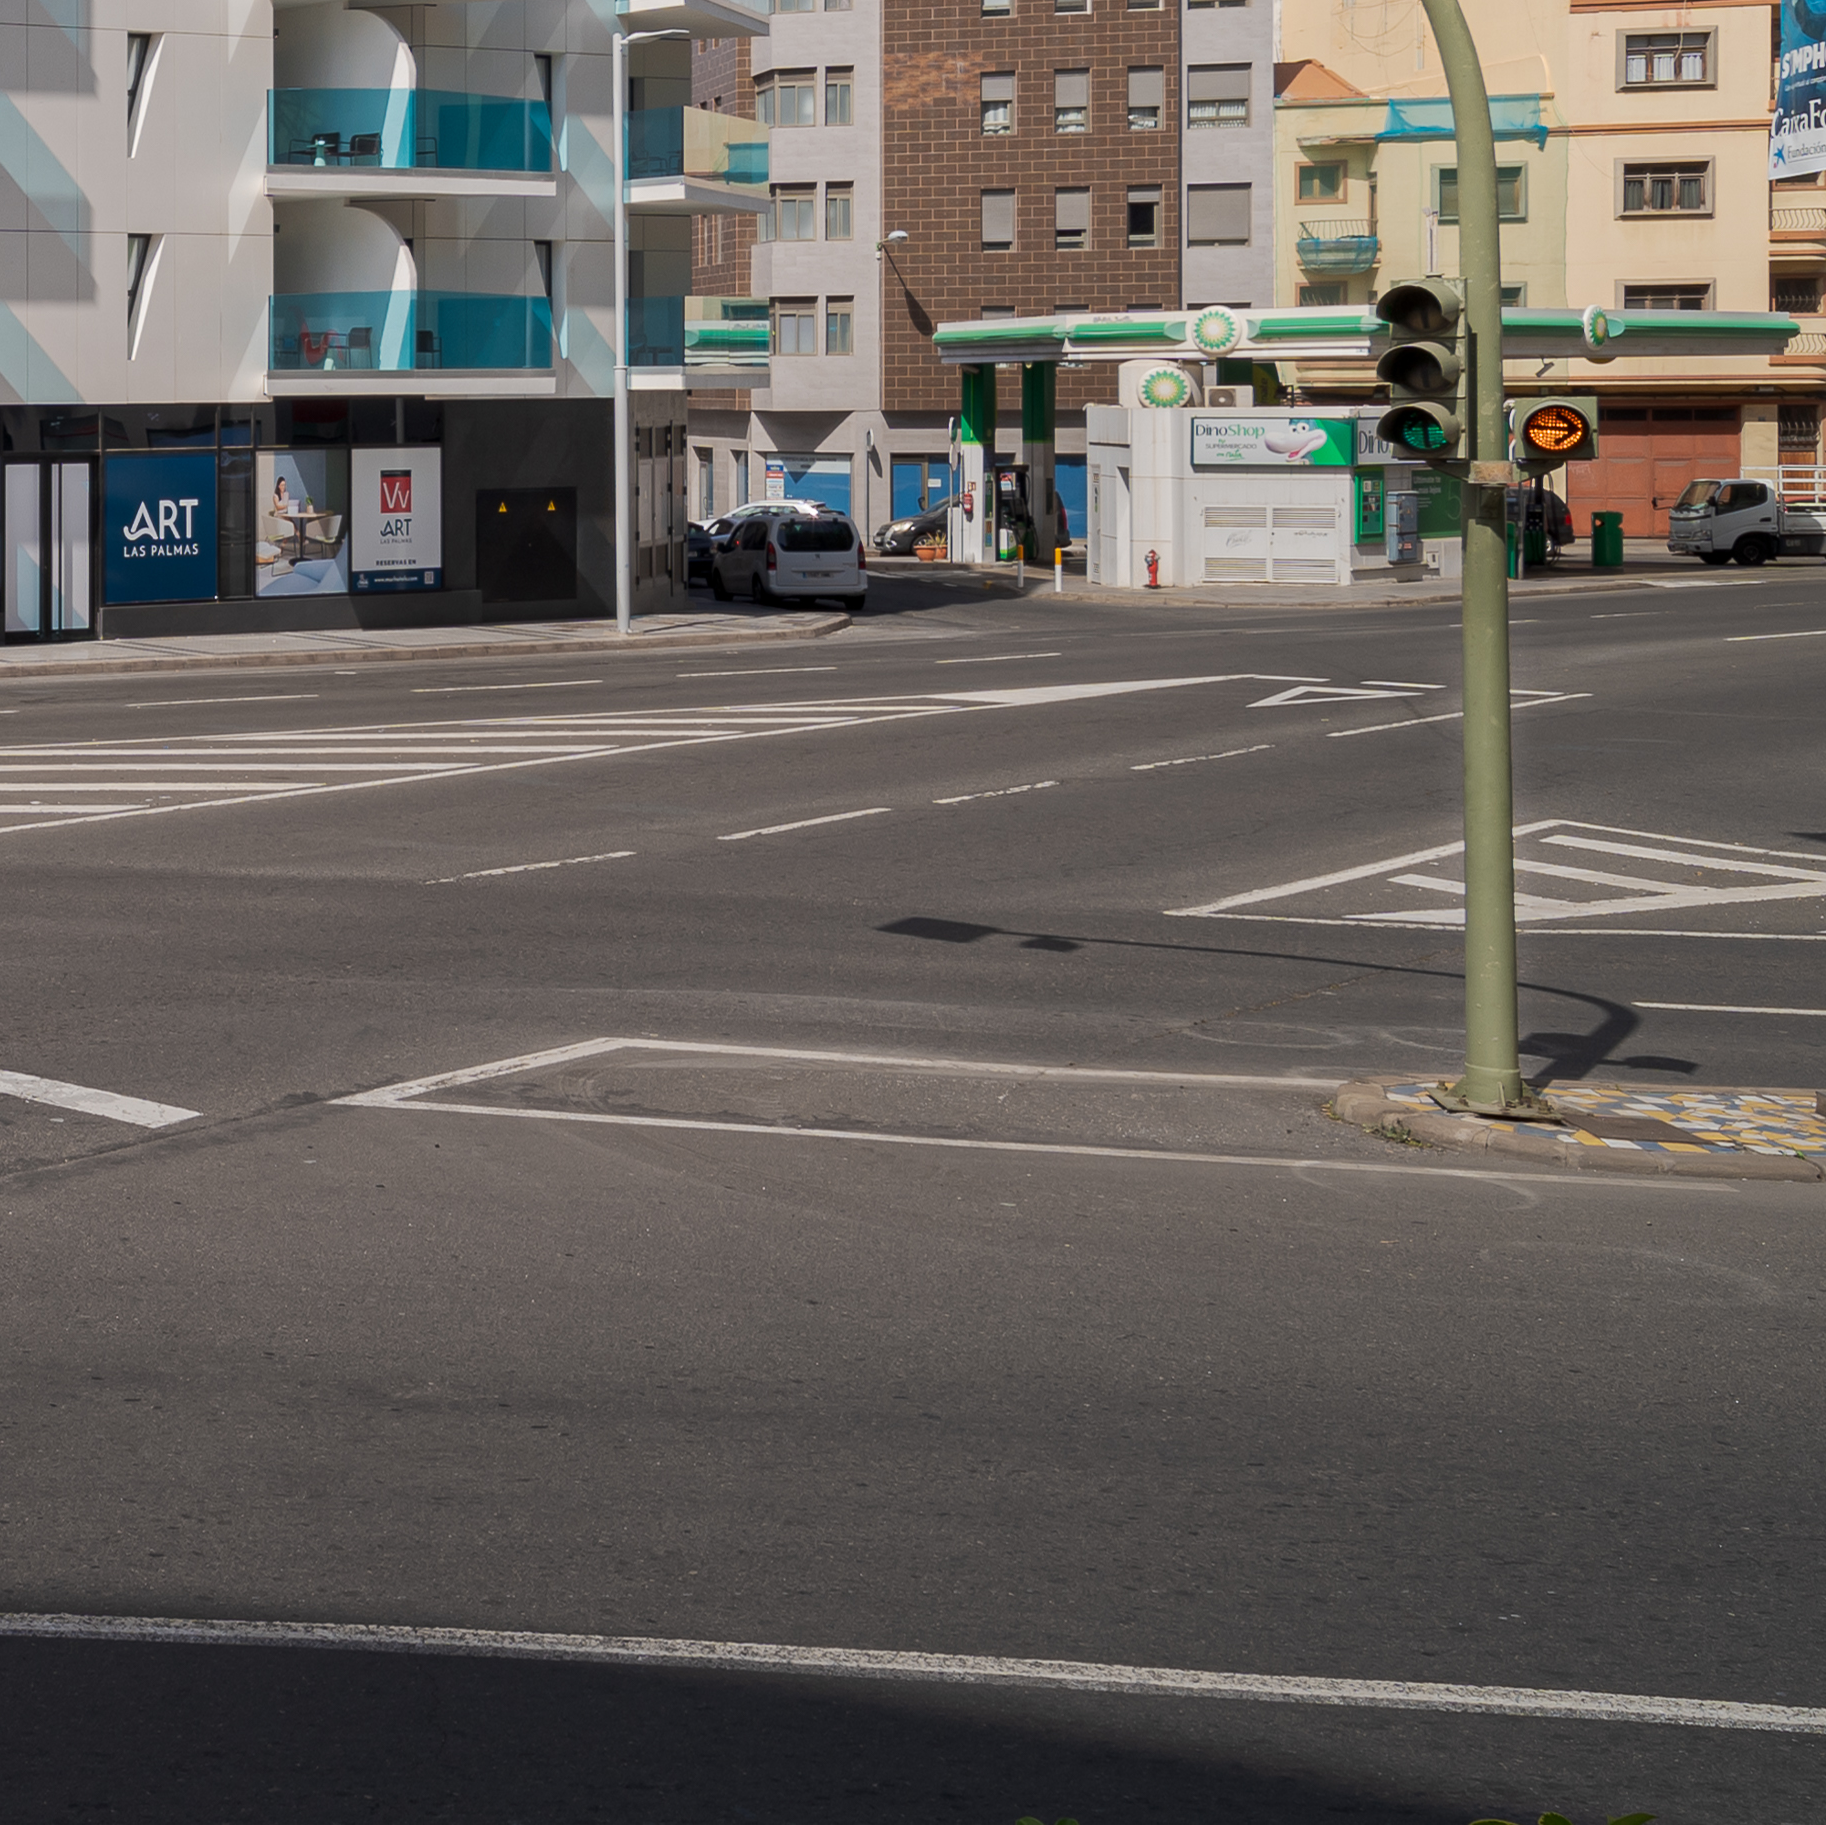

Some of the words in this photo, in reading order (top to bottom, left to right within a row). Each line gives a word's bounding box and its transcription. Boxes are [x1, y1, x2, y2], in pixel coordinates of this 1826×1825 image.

[1195, 424, 1265, 439] DinoShop
[123, 498, 199, 541] ART
[380, 518, 412, 537] ART
[123, 545, 146, 558] LAS
[151, 543, 199, 556] PALMAS
